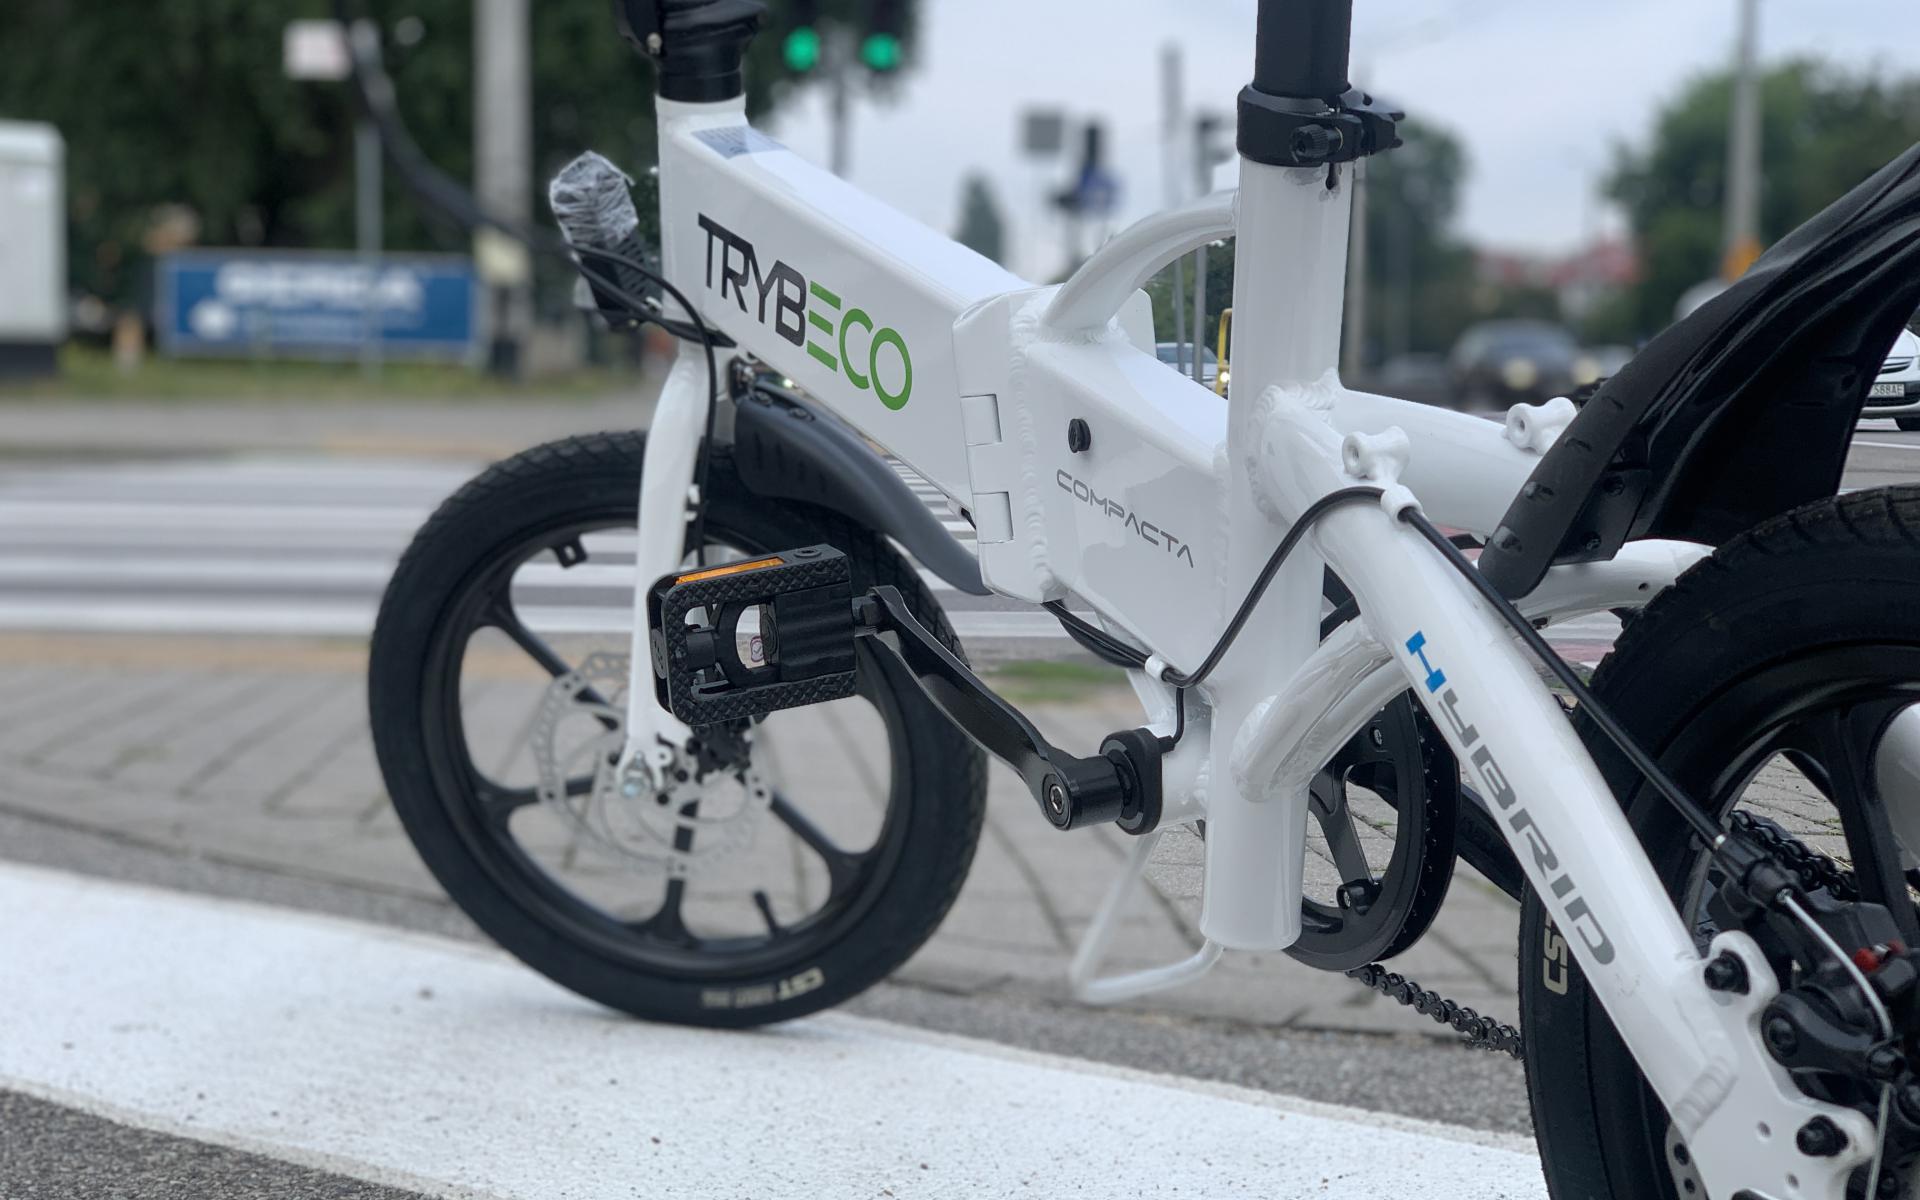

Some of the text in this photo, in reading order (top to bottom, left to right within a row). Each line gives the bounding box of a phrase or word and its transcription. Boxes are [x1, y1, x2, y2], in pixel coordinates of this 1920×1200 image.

[698, 212, 913, 411] TRYBECO
[1056, 468, 1194, 569] COMPACTA
[1405, 630, 1615, 965] HYBRID
